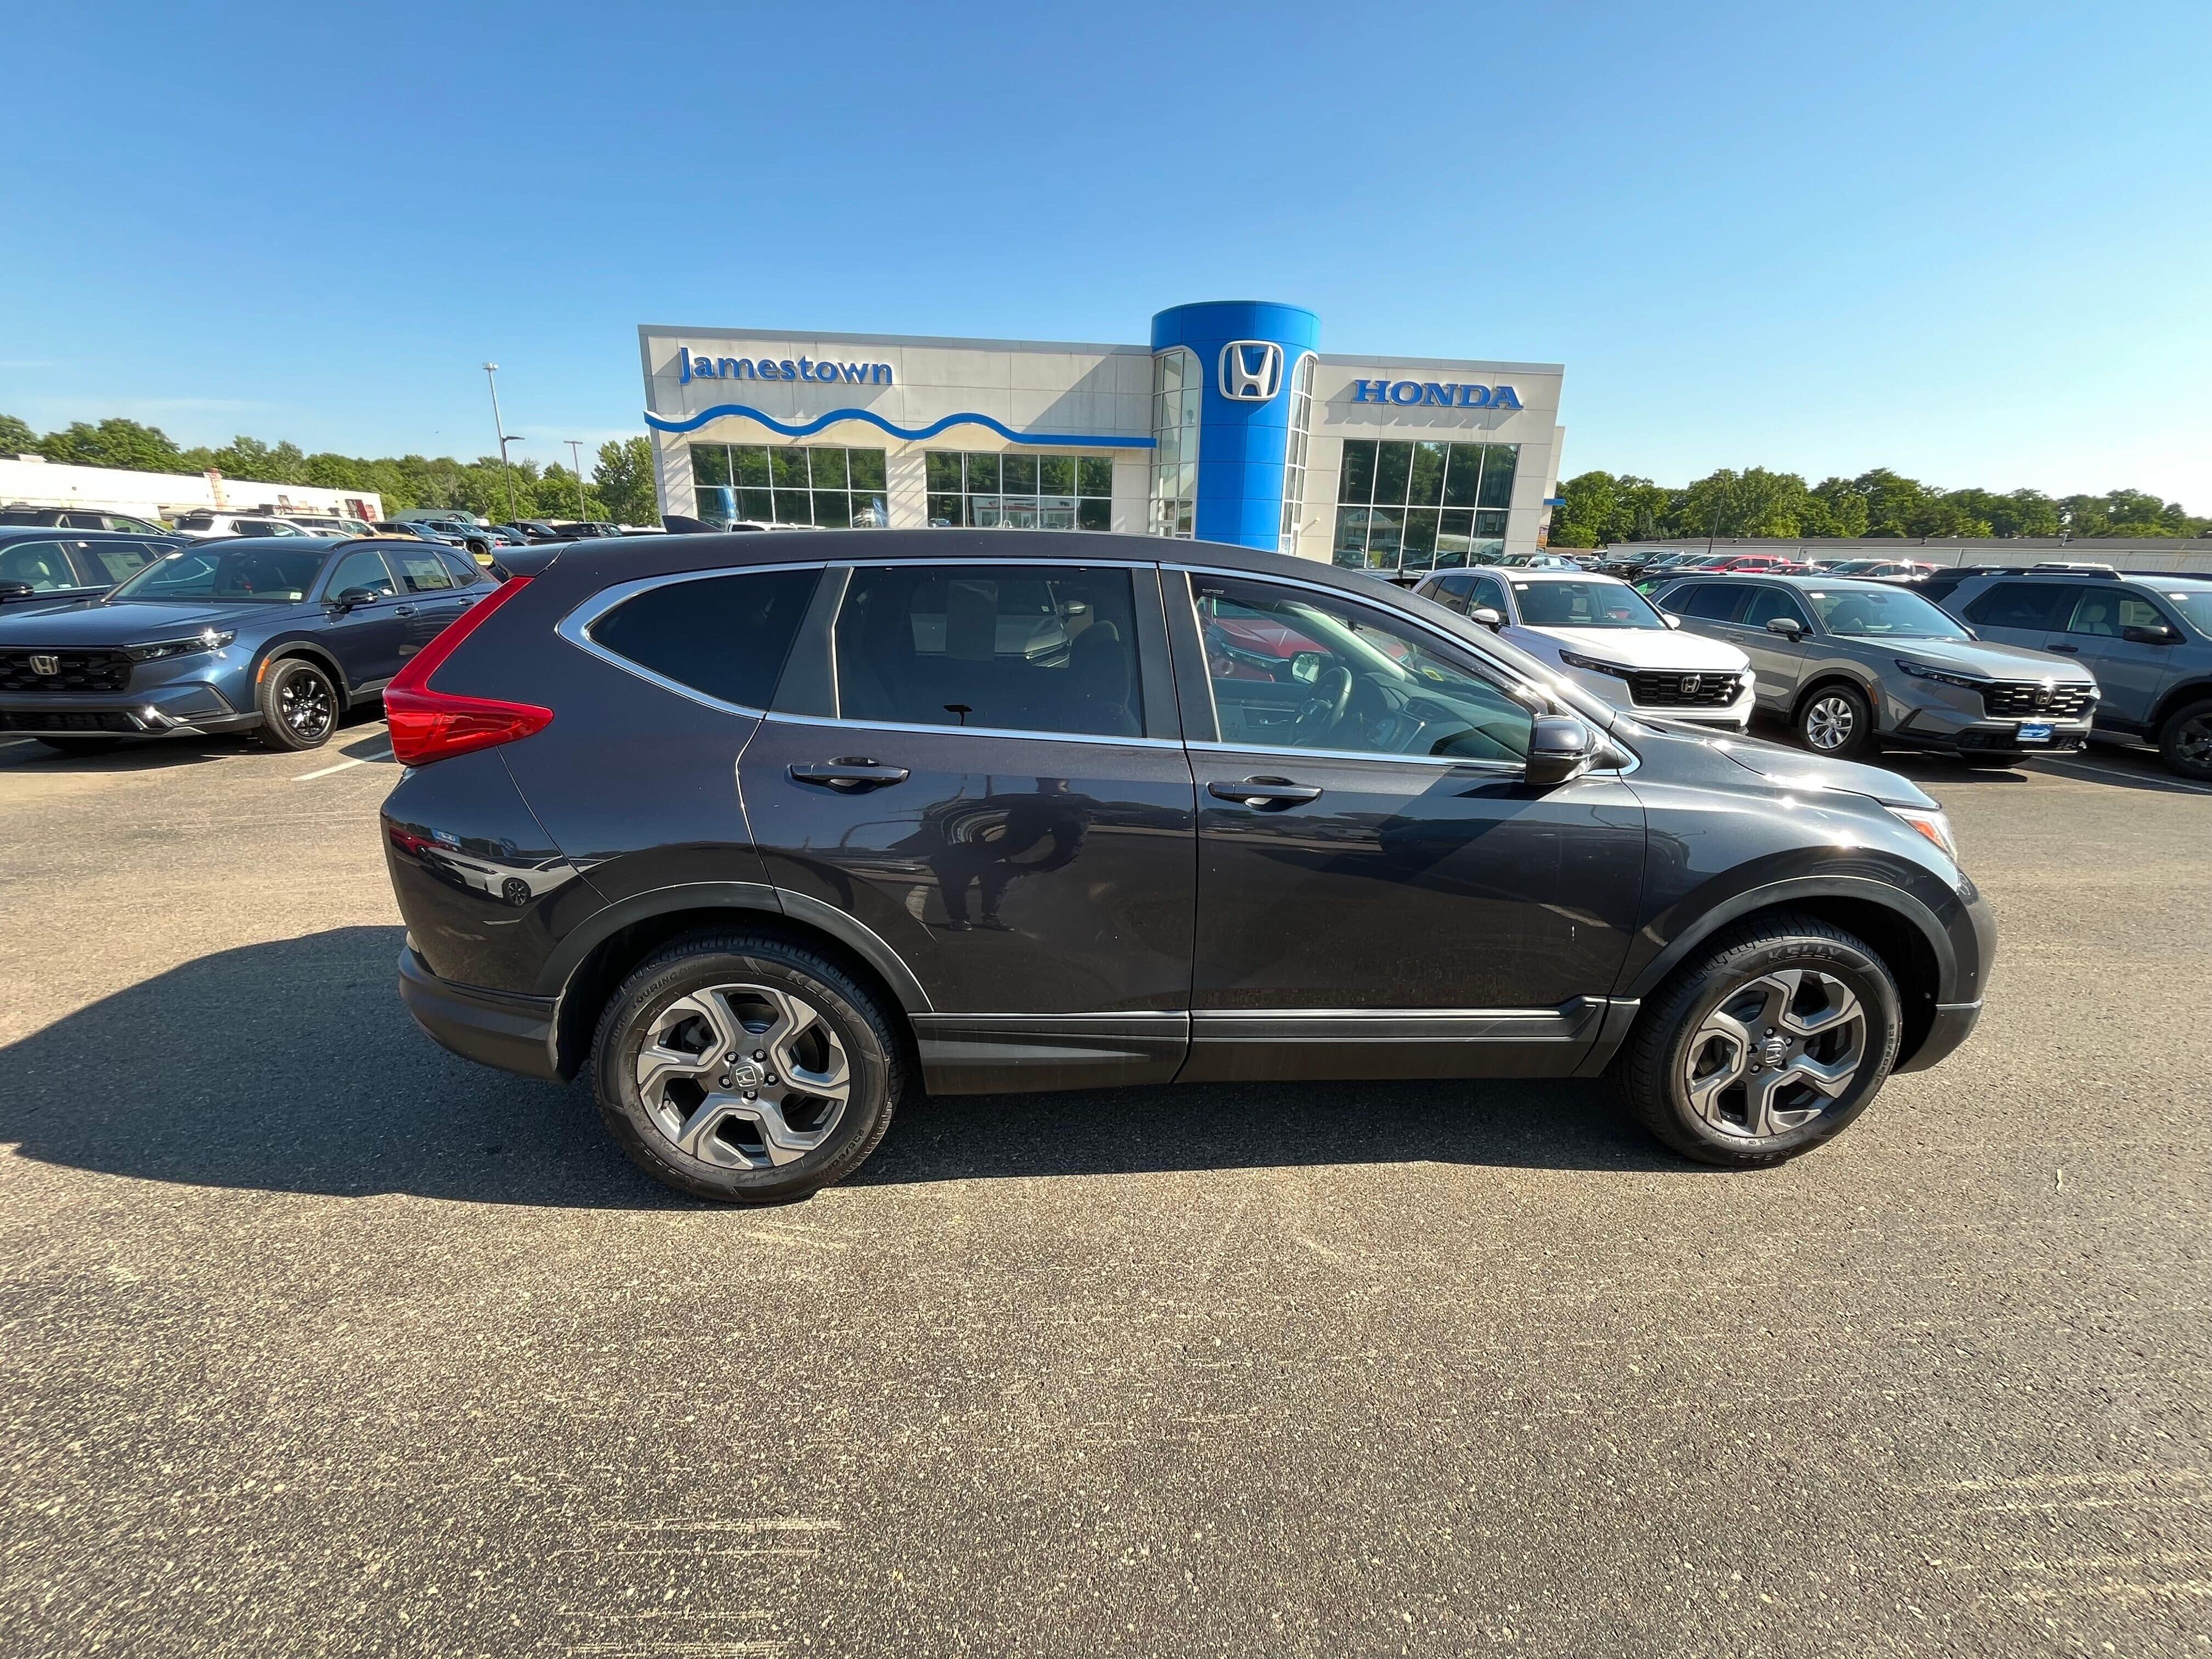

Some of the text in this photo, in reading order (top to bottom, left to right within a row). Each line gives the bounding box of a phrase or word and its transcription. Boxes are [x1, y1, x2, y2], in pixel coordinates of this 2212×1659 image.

[678, 347, 893, 385] Jamestown
[1352, 379, 1524, 410] HONDA
[1768, 944, 1842, 962] KELLY
[632, 972, 677, 1009] TOURING
